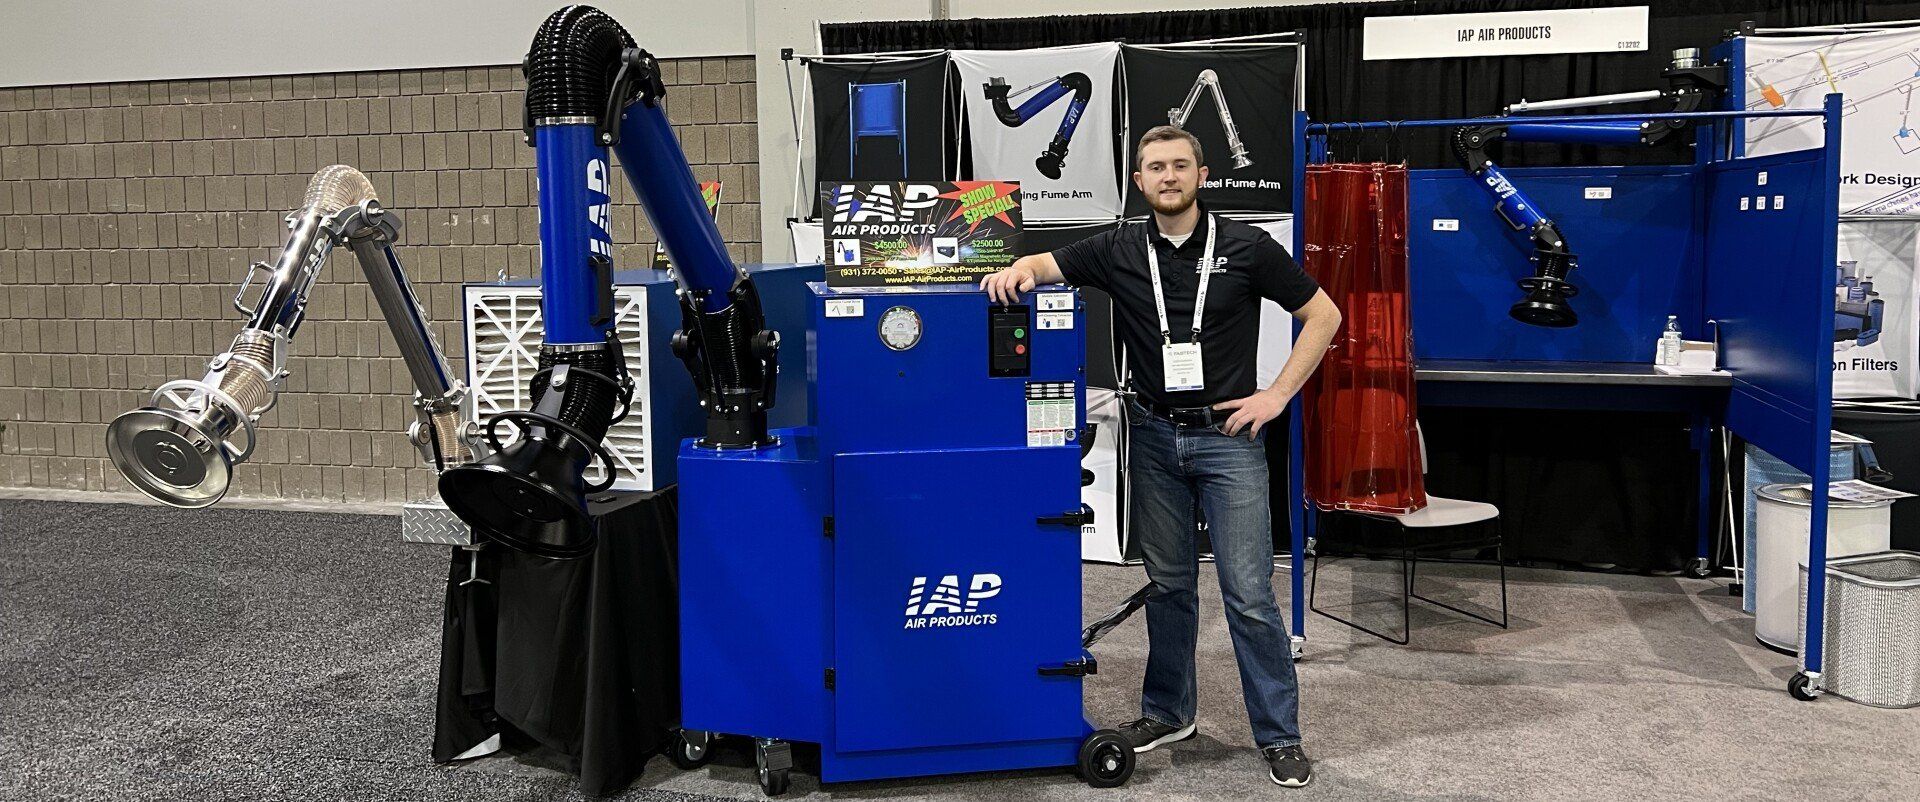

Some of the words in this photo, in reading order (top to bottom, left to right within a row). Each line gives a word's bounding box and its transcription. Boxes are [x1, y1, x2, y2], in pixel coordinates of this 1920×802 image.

[1457, 29, 1474, 42] IAP
[1478, 28, 1495, 41] AIR
[1498, 26, 1551, 41] PRODUCTS
[1198, 179, 1223, 189] teel
[1225, 178, 1256, 188] Fume
[1258, 179, 1281, 190] Arm
[1839, 173, 1859, 185] rk
[960, 183, 997, 208] SHOW
[1041, 190, 1070, 199] Fume
[1071, 189, 1093, 199] Arm
[833, 184, 940, 223] IAP
[963, 194, 1016, 224] SPECIAL!
[831, 224, 857, 236] AIR
[859, 224, 937, 236] PRODUCTS
[874, 240, 908, 250] $4500.00
[971, 239, 1004, 248] $2500.00
[840, 268, 860, 277] (931)
[862, 267, 898, 276] 372-0050
[885, 275, 973, 284] www.IAP-AirProducts.com
[1852, 358, 1898, 371] Filters
[1082, 525, 1096, 534] rm
[905, 573, 1002, 616] IAP
[904, 617, 927, 629] AIR
[929, 613, 998, 628] PRODUCTS
